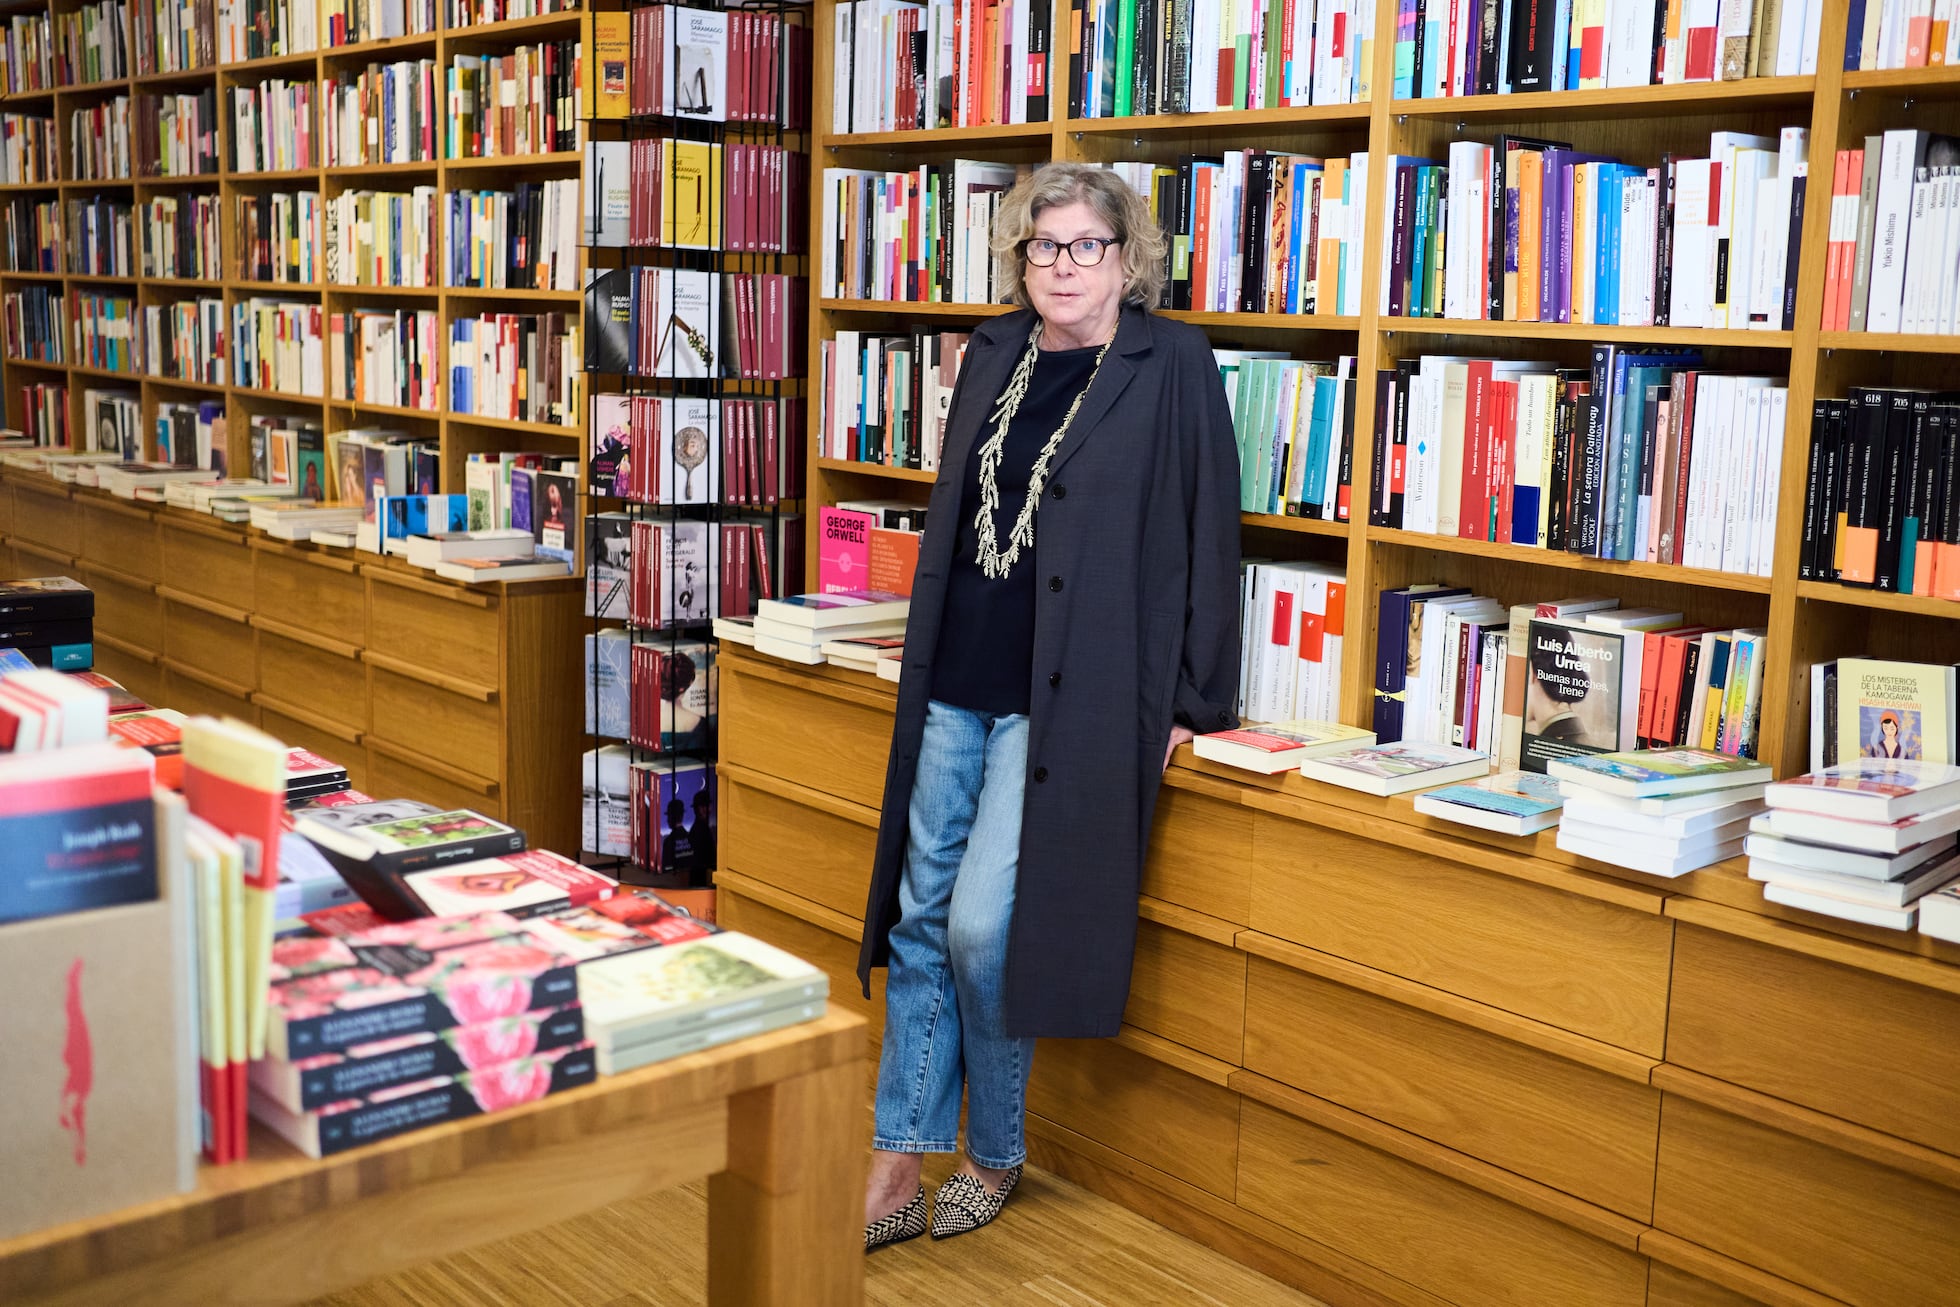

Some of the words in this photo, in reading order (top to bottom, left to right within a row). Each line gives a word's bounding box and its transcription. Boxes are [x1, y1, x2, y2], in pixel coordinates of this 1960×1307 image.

[690, 25, 723, 34] SARAMAGO
[1494, 162, 1502, 178] Wiggin
[1623, 193, 1631, 213] Wilde
[1915, 189, 1925, 218] Mishima
[1930, 184, 1938, 209] Mishima
[1939, 182, 1948, 208] Mishima
[1951, 182, 1960, 208] Mishima
[1885, 213, 1897, 245] Mishima
[1522, 252, 1530, 278] Wilde
[1883, 247, 1894, 268] Yukio
[1615, 368, 1623, 395] Virginia
[1527, 382, 1535, 407] hombre
[1865, 395, 1881, 403] 618
[1894, 398, 1908, 407] 705
[1525, 419, 1533, 436] Todo
[1586, 406, 1599, 454] Dalloway
[1594, 424, 1603, 456] ANOTADA
[1414, 460, 1424, 502] Winterson
[1582, 494, 1592, 504] La
[826, 516, 865, 532] GEORGE
[1581, 514, 1589, 547] VIRGINIA
[1588, 517, 1596, 546] WOOLF
[826, 528, 865, 543] ORWELL
[1616, 526, 1624, 546] Virginia
[1537, 635, 1563, 653] Luis
[1563, 641, 1613, 661] Alberto
[1484, 653, 1493, 672] Woolf
[1555, 654, 1591, 672] Urrea
[1537, 669, 1570, 685] Buenas
[1572, 677, 1609, 693] noches,
[1861, 682, 1871, 690] DE
[1883, 684, 1919, 694] TABERNA
[1862, 675, 1876, 683] LOS
[1877, 676, 1917, 686] MISTERIOS
[1559, 684, 1584, 698] Irene
[1865, 690, 1914, 701] KAMOGAWA
